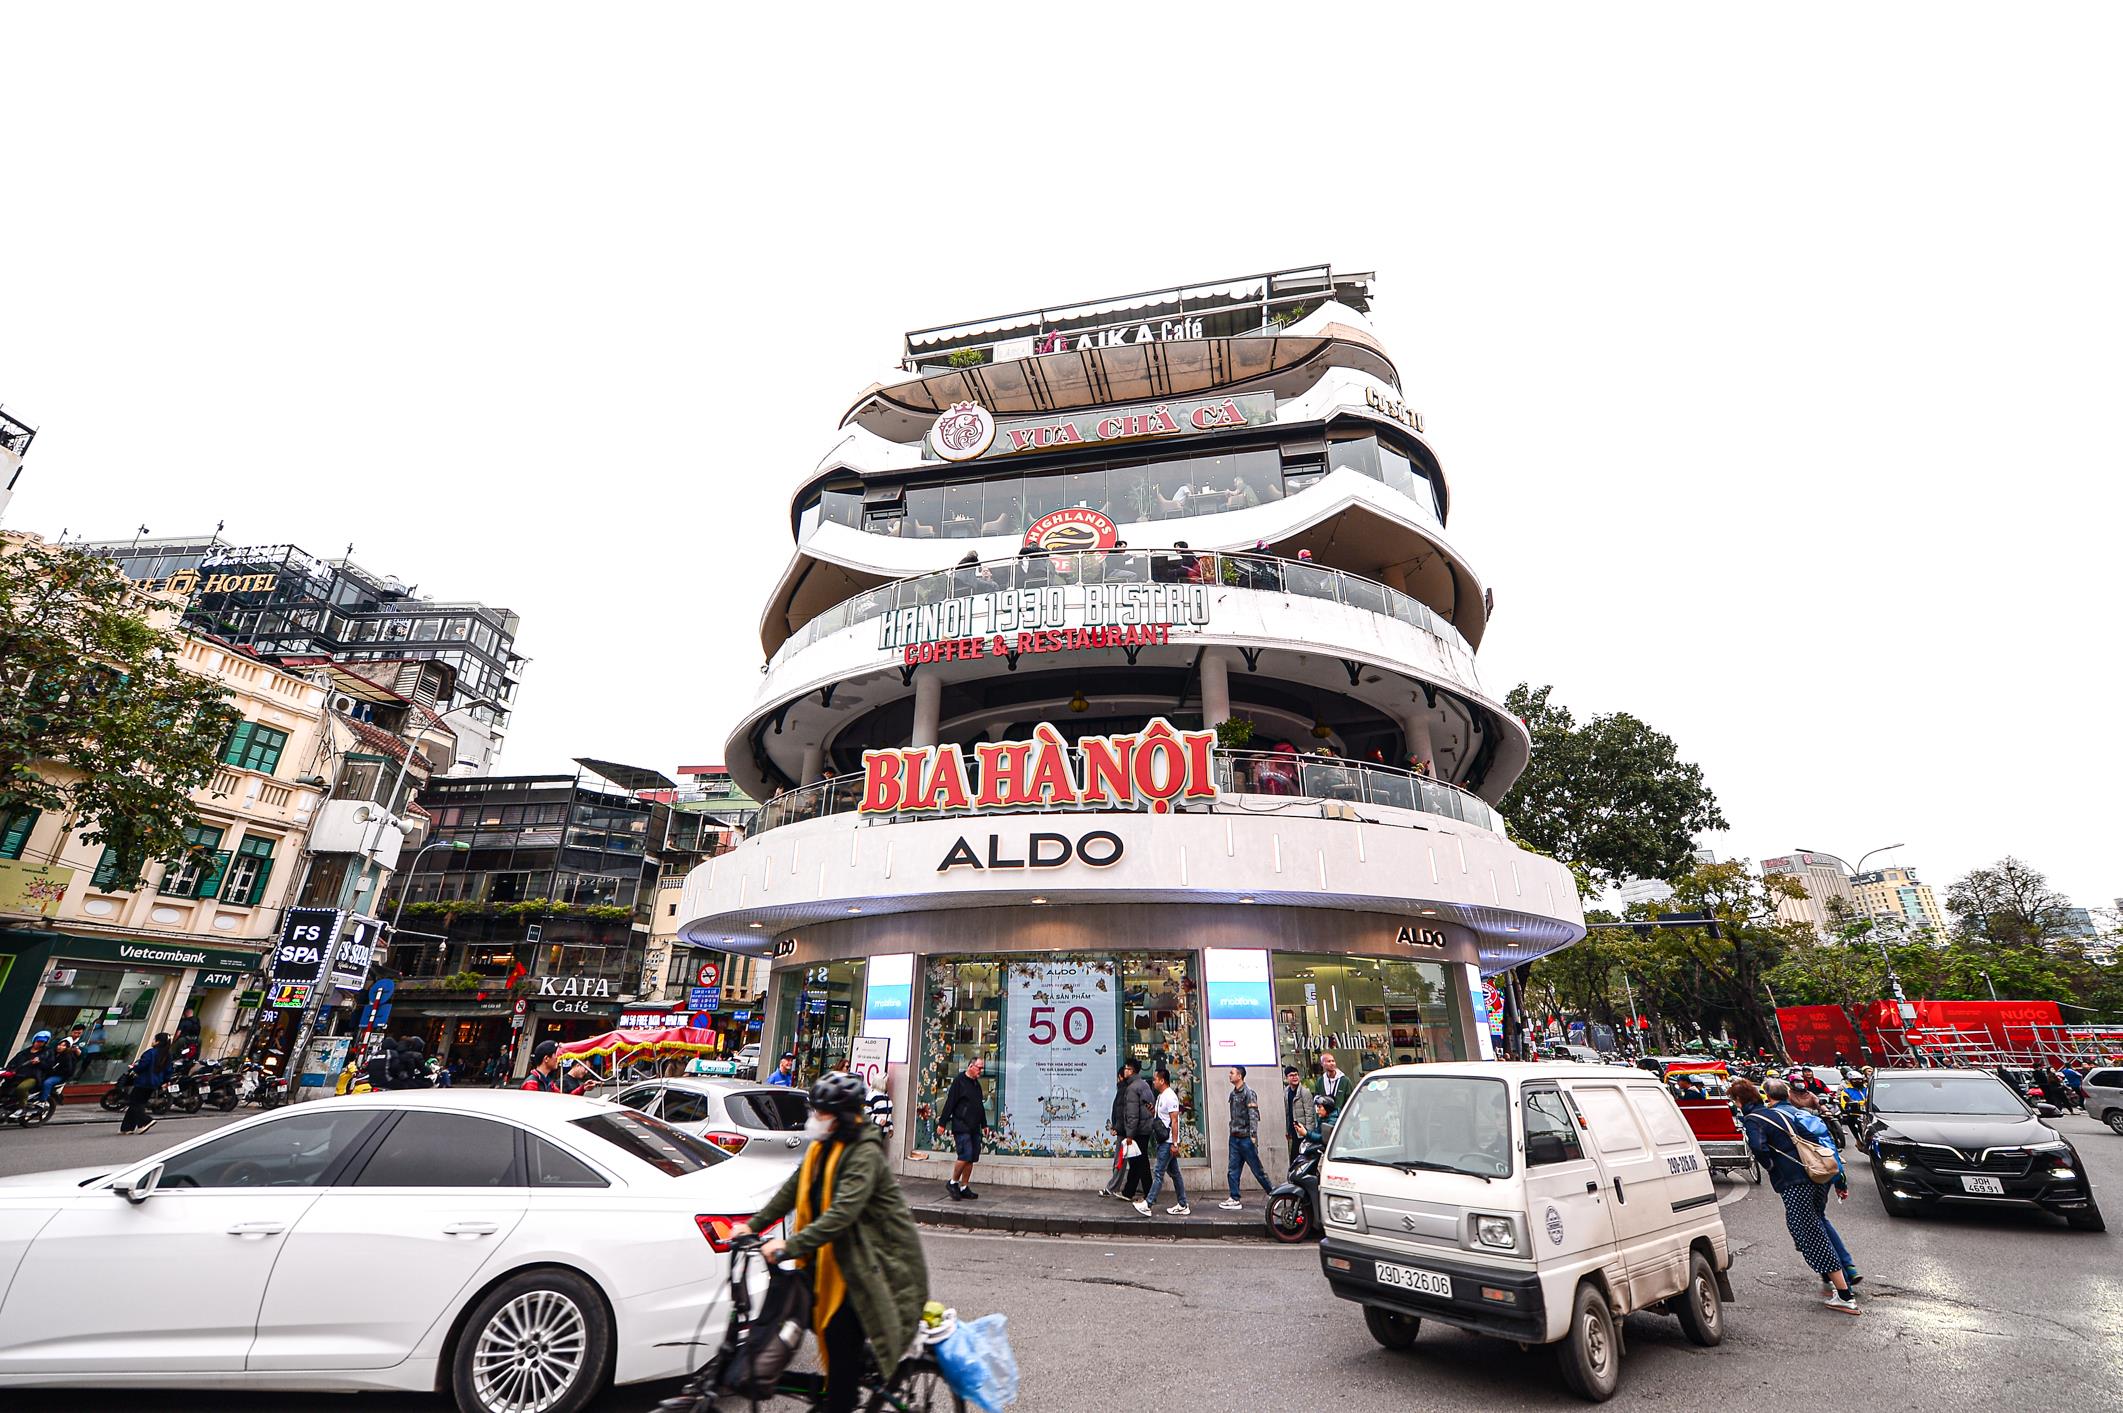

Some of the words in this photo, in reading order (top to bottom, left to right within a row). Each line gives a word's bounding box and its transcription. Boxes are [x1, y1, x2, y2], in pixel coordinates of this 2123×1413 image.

[1160, 316, 1204, 341] Café
[1007, 421, 1084, 451] VUA
[1096, 404, 1182, 441] CHẢ
[1190, 397, 1249, 430] CÁ
[1027, 511, 1113, 543] HIGHLANDS
[203, 573, 278, 593] HOTEL
[878, 596, 975, 651] HANOI
[985, 586, 1066, 632] 1930
[1083, 583, 1211, 627] BISTRO
[904, 636, 985, 666] COFFEE
[991, 634, 1009, 656] &
[1017, 622, 1173, 655] RESTAURANT
[859, 745, 970, 814] BIA
[975, 723, 1077, 808] HÀ
[1080, 718, 1218, 815] NỘI
[936, 830, 1125, 873] ALDO
[293, 925, 321, 941] FS
[1395, 926, 1447, 950] ALDO
[119, 944, 207, 964] Vietcombank
[280, 945, 319, 962] SPA
[335, 940, 352, 961] FS
[348, 943, 370, 967] SPA
[204, 973, 232, 984] ATM
[537, 976, 610, 998] KAFA
[552, 999, 589, 1013] Café
[1028, 1006, 1095, 1046] 50
[1971, 1177, 1991, 1186] 30H
[1377, 1264, 1450, 1295] 29D-326.06
